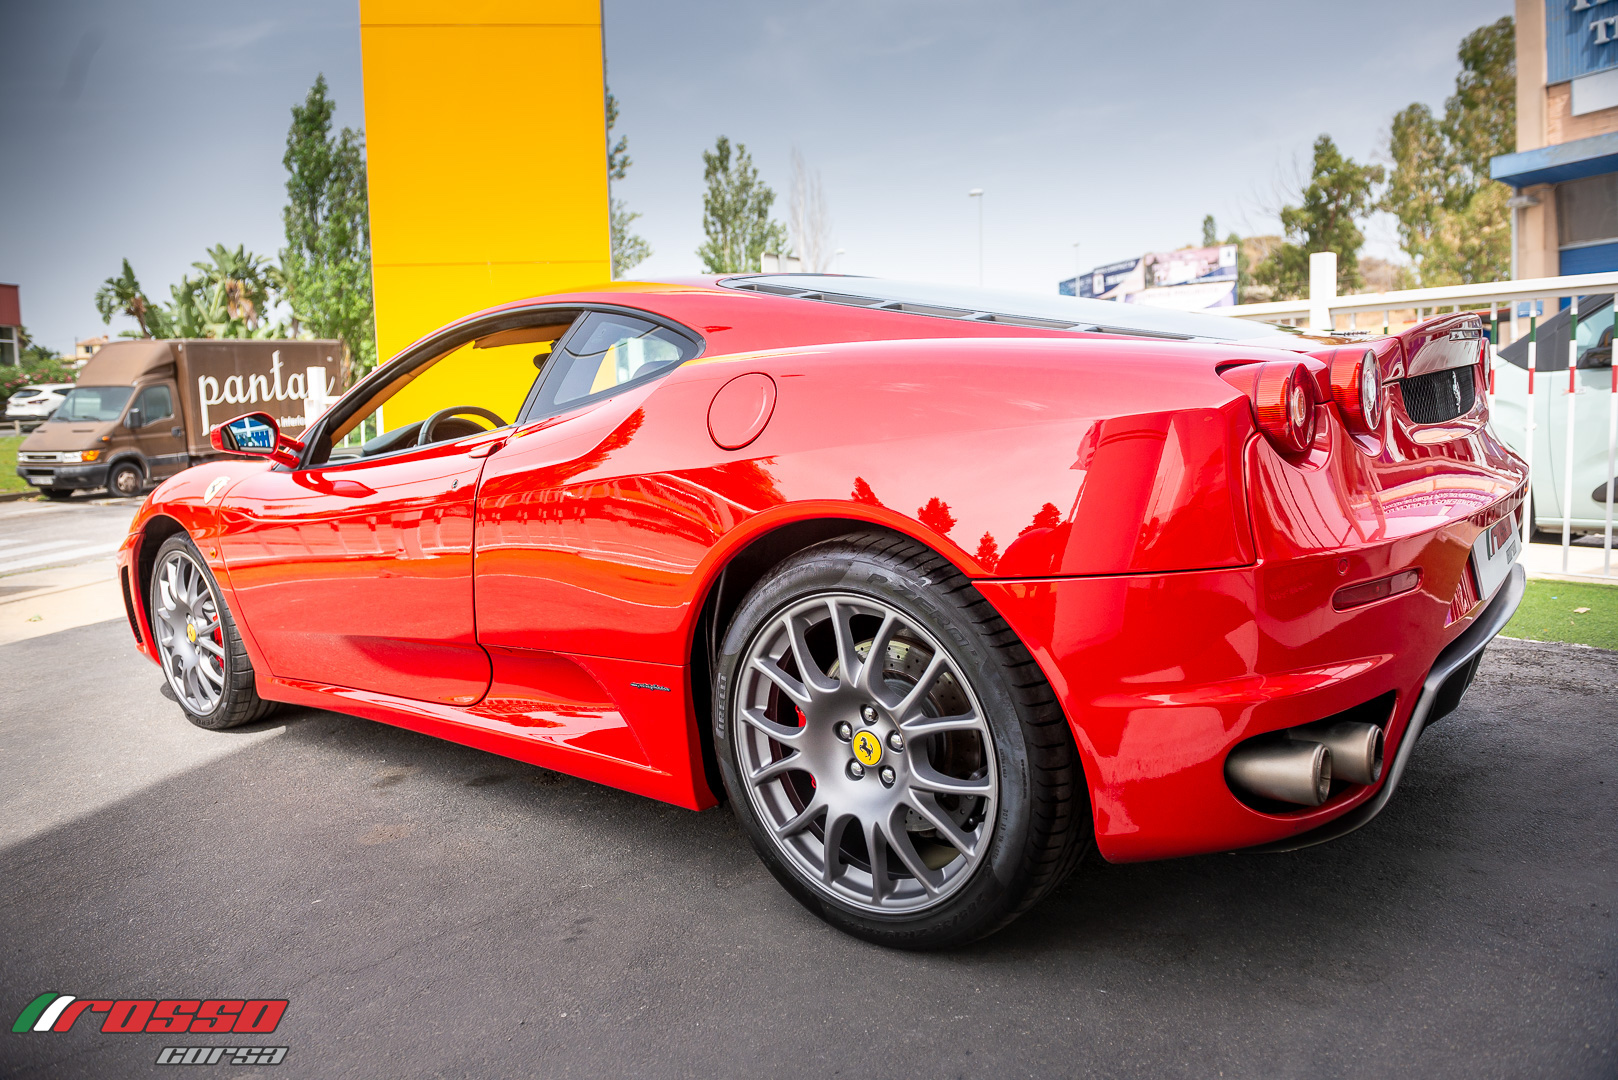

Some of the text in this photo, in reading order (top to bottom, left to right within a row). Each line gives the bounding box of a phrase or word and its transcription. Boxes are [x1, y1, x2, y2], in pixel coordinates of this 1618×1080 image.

[198, 349, 335, 437] panta
[281, 414, 306, 428] interio
[892, 586, 970, 648] ZERO
